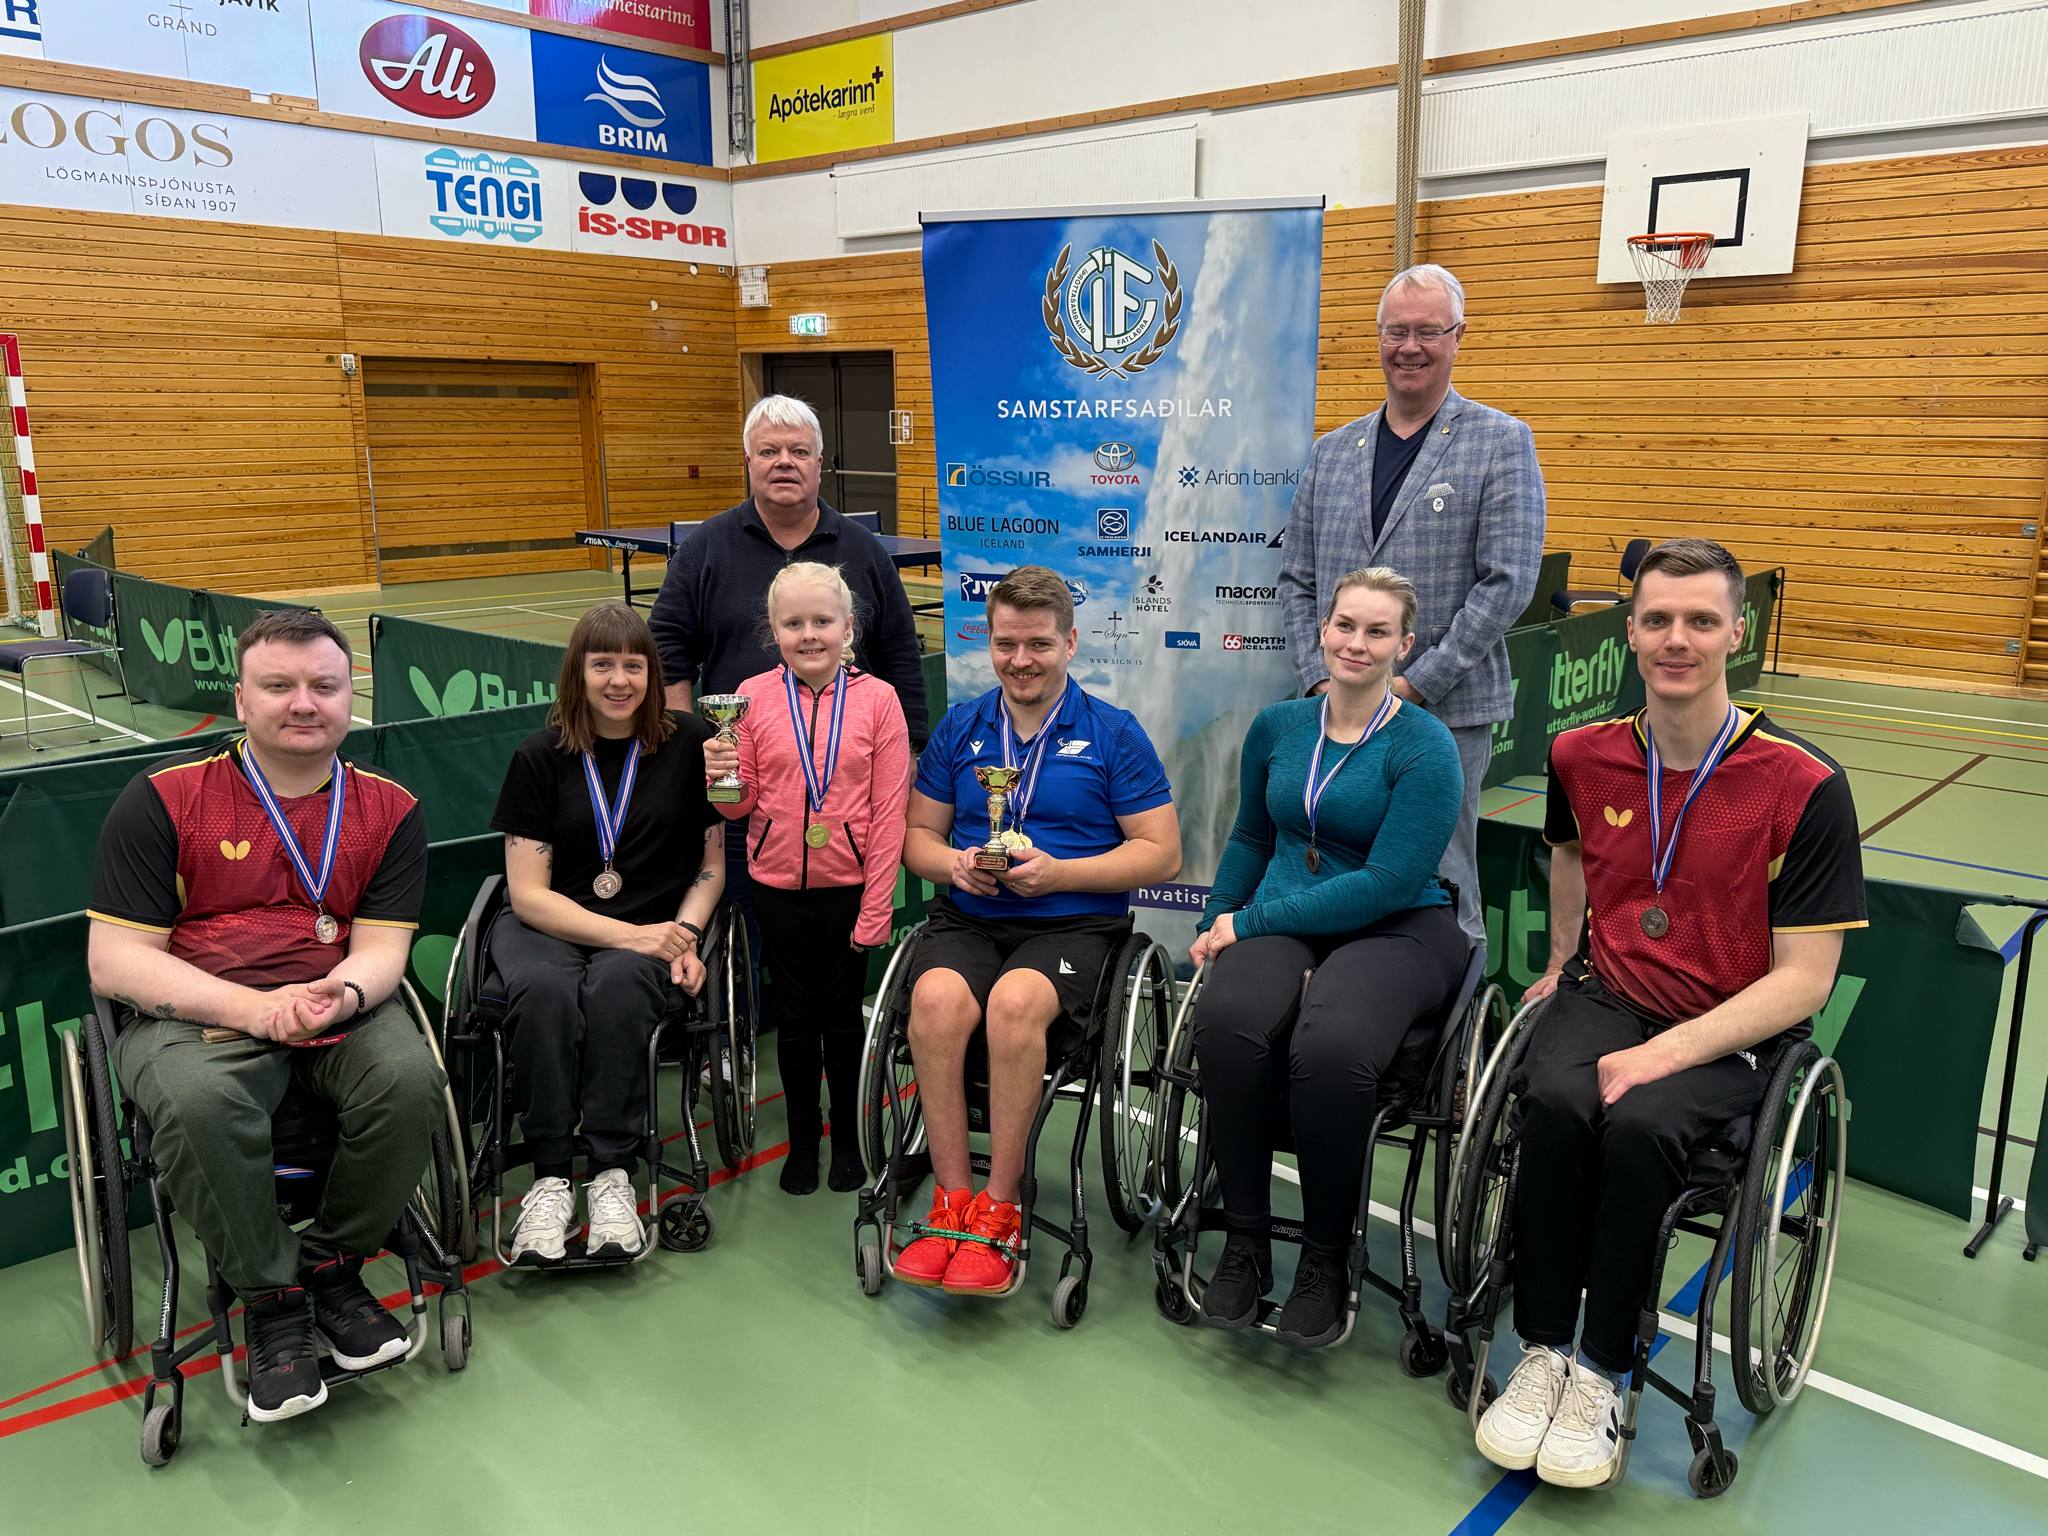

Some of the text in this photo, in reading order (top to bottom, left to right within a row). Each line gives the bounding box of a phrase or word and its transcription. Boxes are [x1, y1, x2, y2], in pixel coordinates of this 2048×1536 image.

[148, 14, 217, 37] GRAND
[370, 33, 476, 104] Ali
[769, 79, 875, 122] Apótekarinn
[0, 102, 234, 168] OGOS
[598, 124, 668, 153] BRIM
[45, 166, 235, 196] LÖGMANNSÞJÓNUSTA
[145, 193, 236, 213] SÍÐAN 1907
[425, 170, 543, 222] TENGI
[997, 398, 1233, 419] SAMSTARFSAÐILAR
[969, 464, 1051, 487] ÖSSUR
[1090, 474, 1140, 486] TOYOTA
[1204, 468, 1299, 486] Arion banki
[948, 515, 1059, 535] BLUE LAGOON
[980, 538, 1025, 549] ICELAND
[1165, 530, 1267, 544] ICELANDAIR
[1077, 546, 1151, 557] SAMHERJI
[1242, 637, 1286, 645] NORTH
[1548, 636, 1628, 710] tterfly
